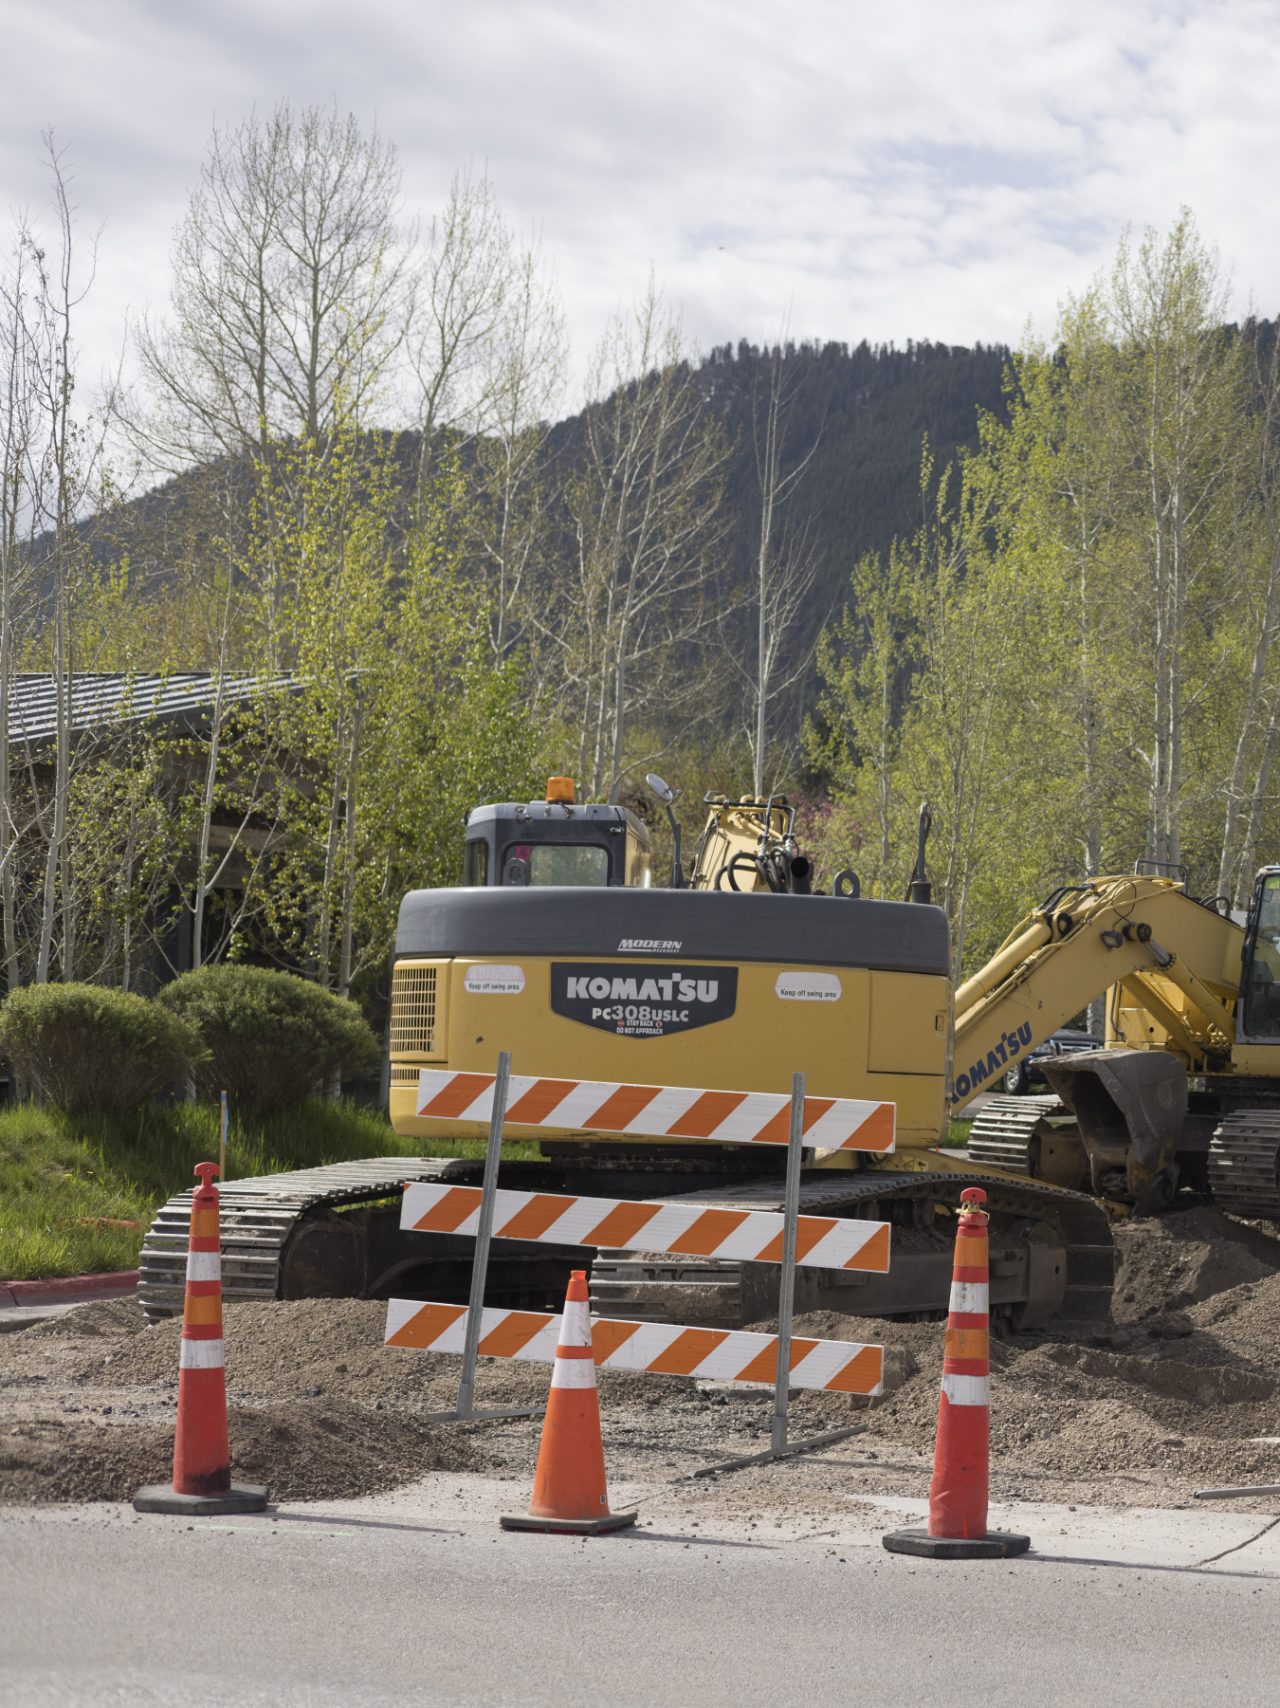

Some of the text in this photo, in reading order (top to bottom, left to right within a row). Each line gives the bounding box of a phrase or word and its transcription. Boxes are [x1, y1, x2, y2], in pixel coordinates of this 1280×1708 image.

[618, 939, 682, 949] MODERN
[469, 983, 481, 991] Keep
[566, 972, 719, 1003] KOMATSU
[781, 989, 796, 997] Keep
[797, 989, 806, 997] off
[807, 990, 822, 998] swing
[592, 1005, 689, 1022] PC308USLC
[635, 1027, 664, 1035] APPROACH
